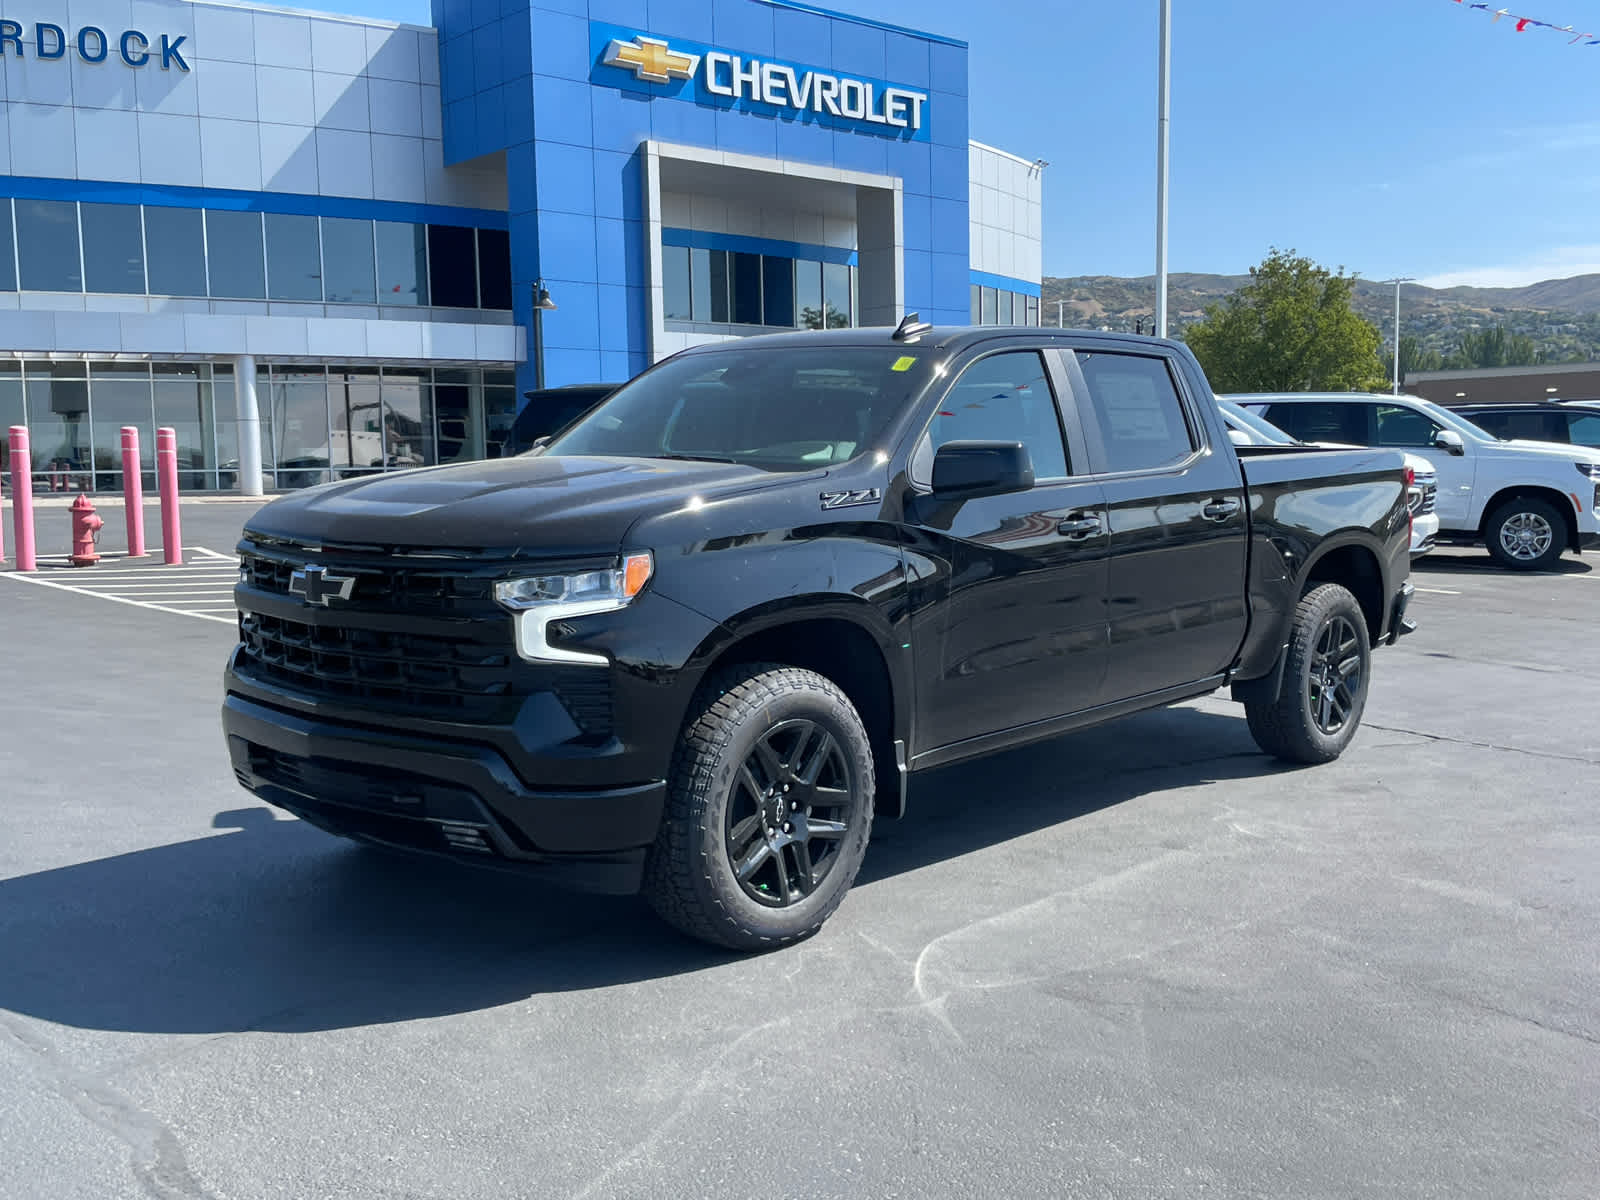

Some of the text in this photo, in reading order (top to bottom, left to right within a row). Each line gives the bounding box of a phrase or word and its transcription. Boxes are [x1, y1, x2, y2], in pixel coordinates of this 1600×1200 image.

[0, 19, 191, 72] RDOCK
[706, 51, 927, 129] CHEVROLET
[820, 488, 880, 511] Z71
